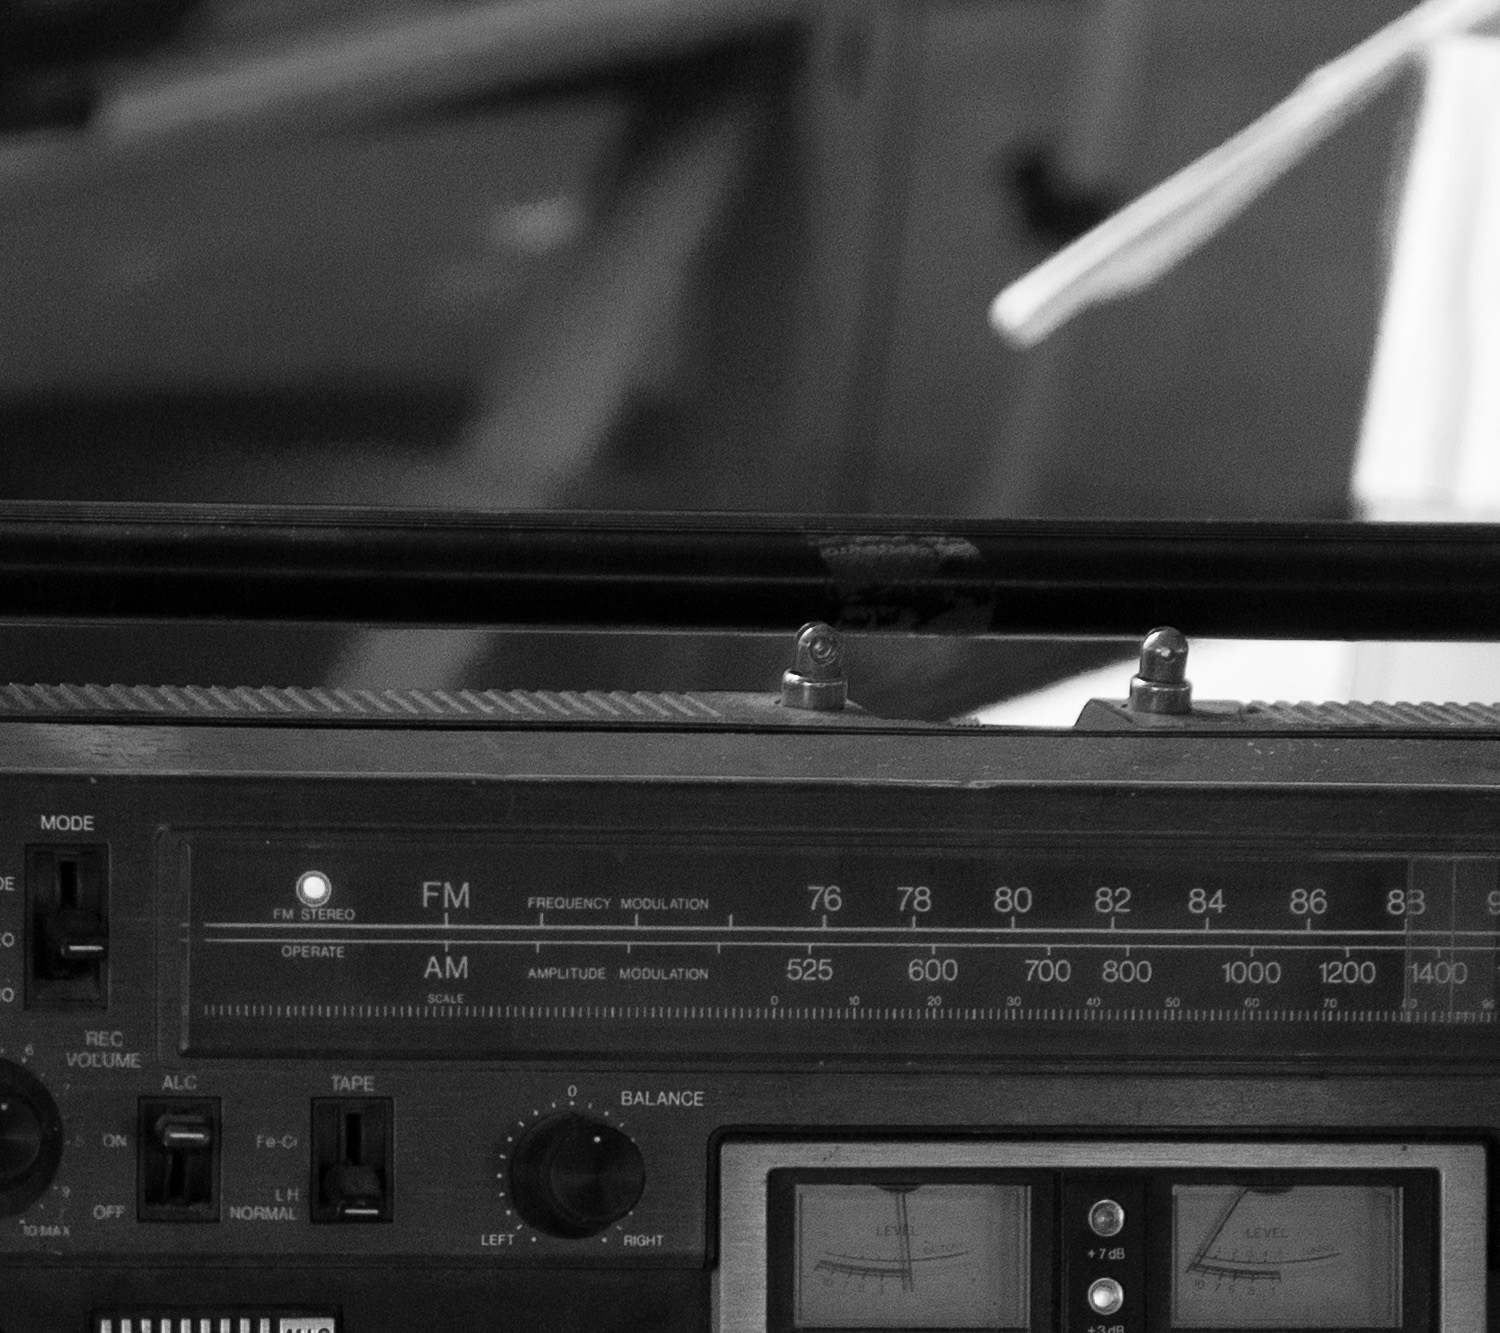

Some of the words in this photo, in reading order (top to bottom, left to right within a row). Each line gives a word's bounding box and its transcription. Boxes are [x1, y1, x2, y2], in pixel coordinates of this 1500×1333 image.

[40, 815, 95, 832] MODE
[421, 881, 471, 909] FM
[807, 885, 842, 912] 76
[897, 885, 932, 913] 78
[993, 886, 1033, 914] 80
[1094, 886, 1132, 914] 82
[1187, 887, 1227, 915] 84
[1289, 888, 1328, 915] 86
[1386, 889, 1426, 916] 88
[527, 897, 612, 911] FREQUENCY
[620, 897, 710, 911] MODULATION
[273, 908, 294, 921] FM
[300, 908, 356, 921] STEREO
[281, 945, 346, 959] OPERATE
[423, 955, 469, 979] AM
[527, 966, 607, 981] AMPLITUDE
[619, 966, 710, 981] MODULATION
[785, 957, 834, 982] 525
[907, 958, 959, 982] 600
[1024, 958, 1072, 983] 700
[1101, 959, 1153, 983] 800
[1222, 960, 1282, 985] 1000
[1318, 960, 1377, 985] 1200
[1410, 960, 1469, 985] 1400
[427, 993, 465, 1004] SCALE
[770, 996, 779, 1006] 0
[927, 996, 942, 1007] 20
[1006, 996, 1022, 1007] 30
[1086, 997, 1101, 1008] 40
[1165, 997, 1180, 1008] 50
[1244, 998, 1260, 1008] 60
[1323, 998, 1338, 1009] 70
[85, 1031, 123, 1048] REC
[24, 1043, 35, 1056] 6
[65, 1052, 142, 1069] VOLUME
[162, 1076, 198, 1091] ALC
[331, 1075, 376, 1092] TAPE
[566, 1085, 578, 1098] 0
[620, 1091, 705, 1107] BALANCE
[102, 1135, 128, 1149] ON
[93, 1205, 126, 1220] OFF
[229, 1206, 298, 1221] NORMAL
[40, 1225, 71, 1237] MAX
[1245, 1227, 1289, 1239] LEVEL
[480, 1234, 515, 1247] LEFT
[623, 1235, 665, 1248] RIGHT
